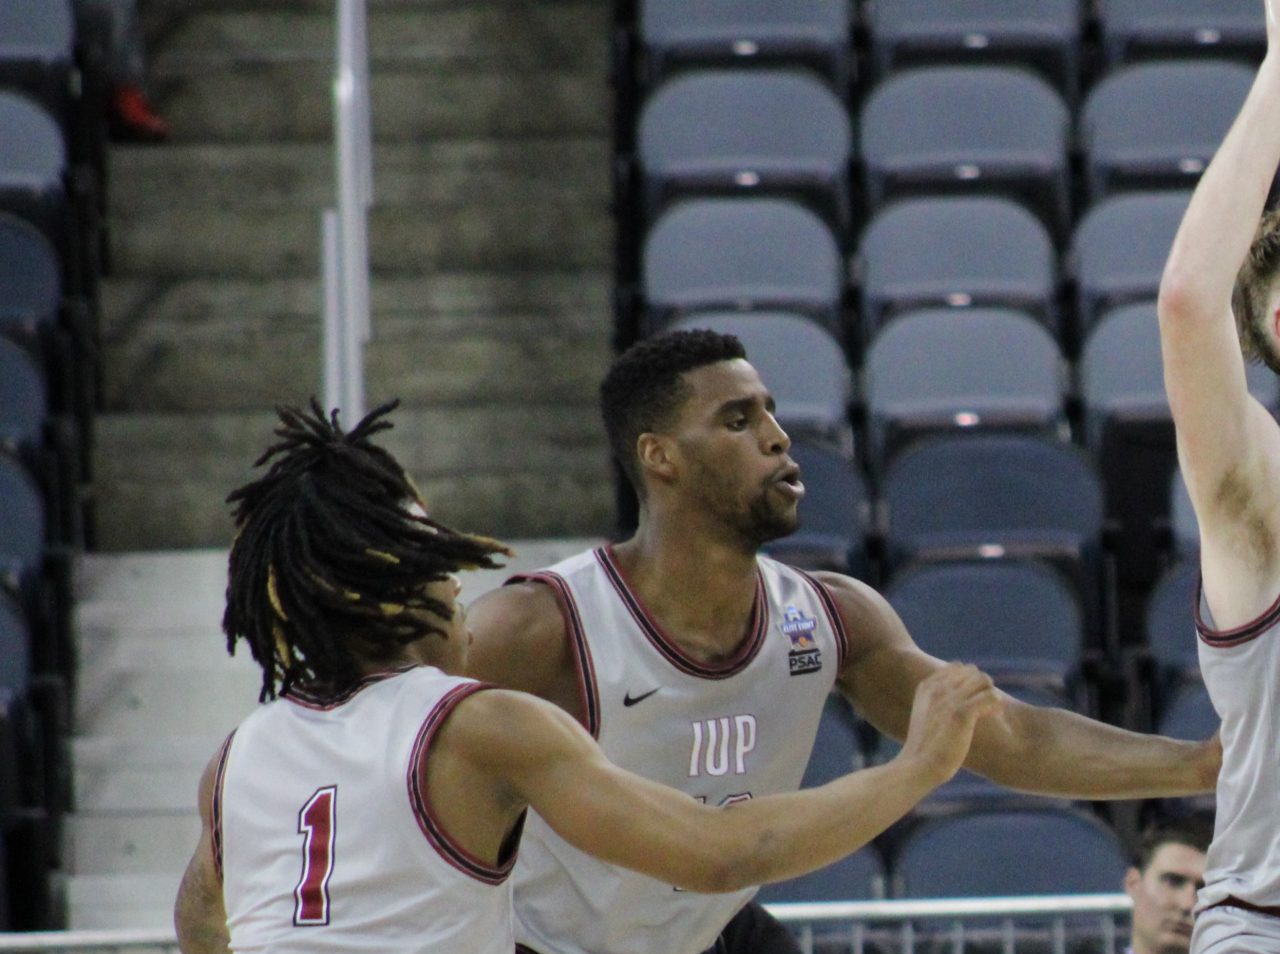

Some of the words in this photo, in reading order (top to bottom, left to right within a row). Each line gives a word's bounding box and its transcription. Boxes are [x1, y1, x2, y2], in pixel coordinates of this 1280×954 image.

[789, 653, 822, 670] PSAC
[687, 713, 757, 778] IUP
[292, 783, 338, 928] 1
